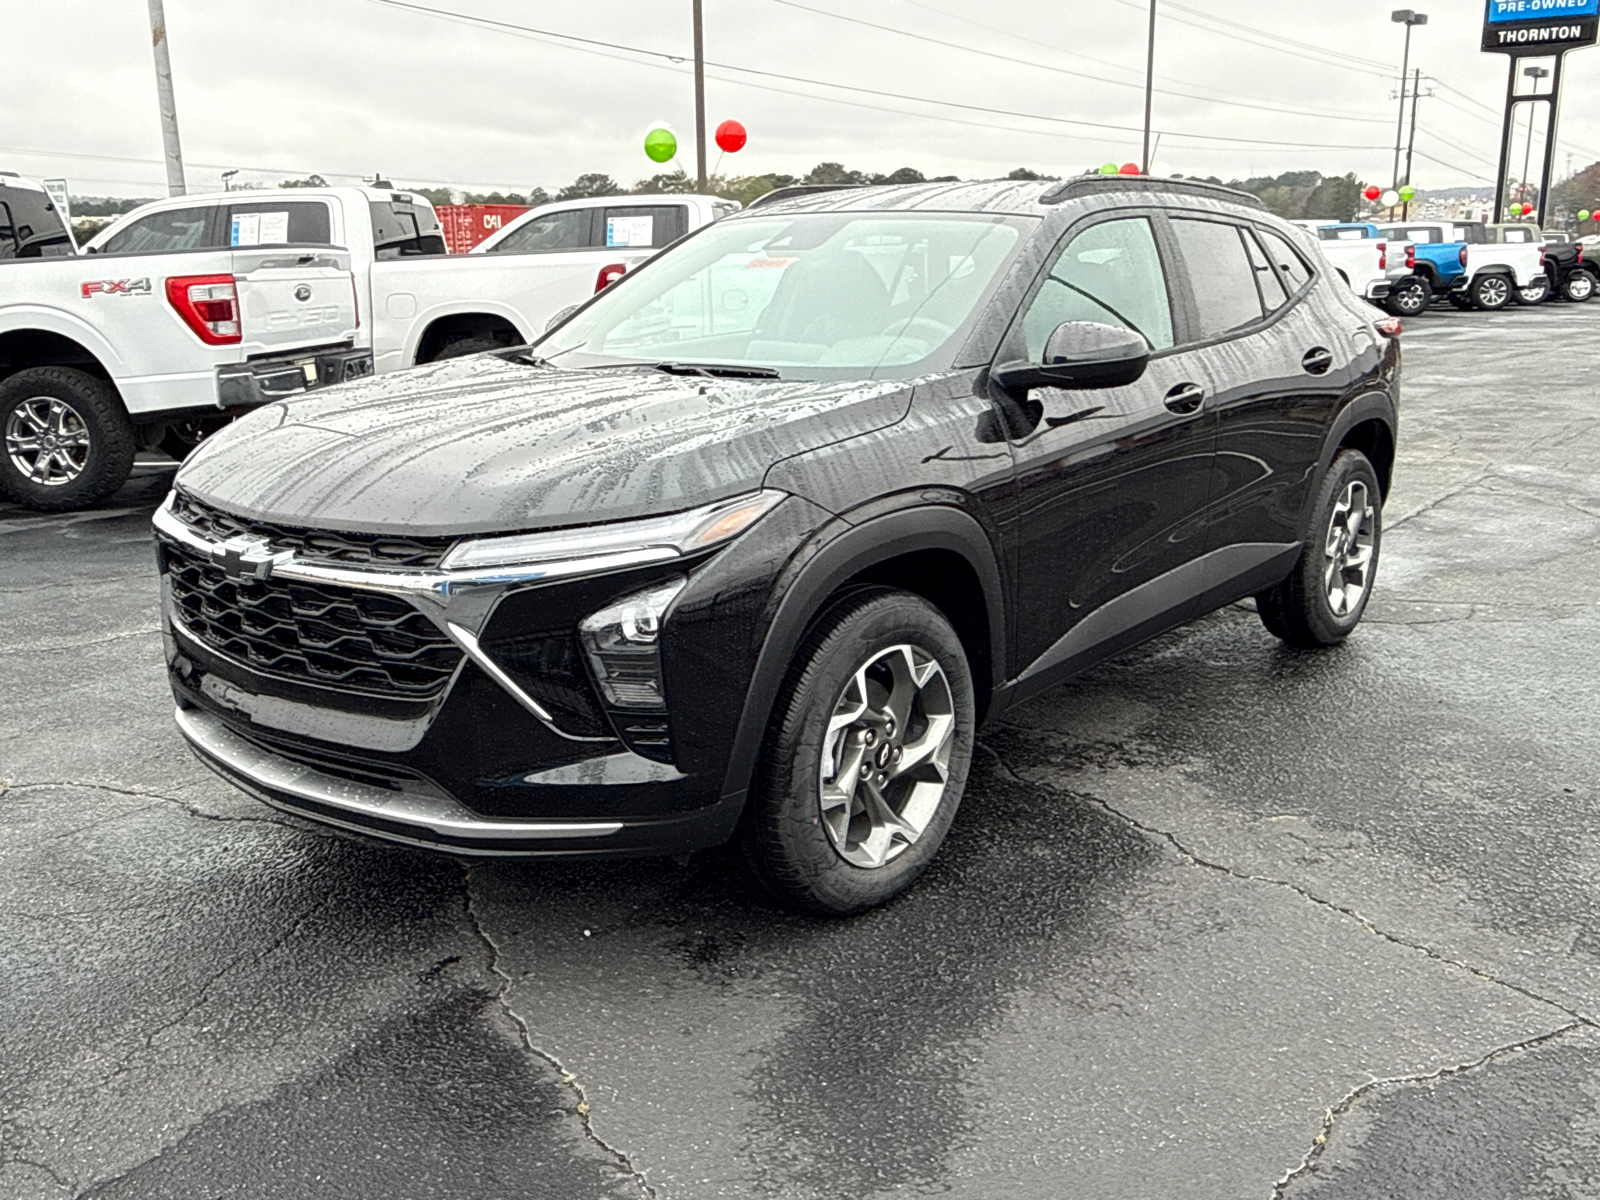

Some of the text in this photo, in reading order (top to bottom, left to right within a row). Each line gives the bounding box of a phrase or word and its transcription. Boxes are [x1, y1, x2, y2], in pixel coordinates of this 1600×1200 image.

[1498, 0, 1587, 13] PRE-OWNED
[1498, 25, 1581, 43] THORNTON
[483, 215, 501, 229] CAI
[81, 277, 151, 298] FX4
